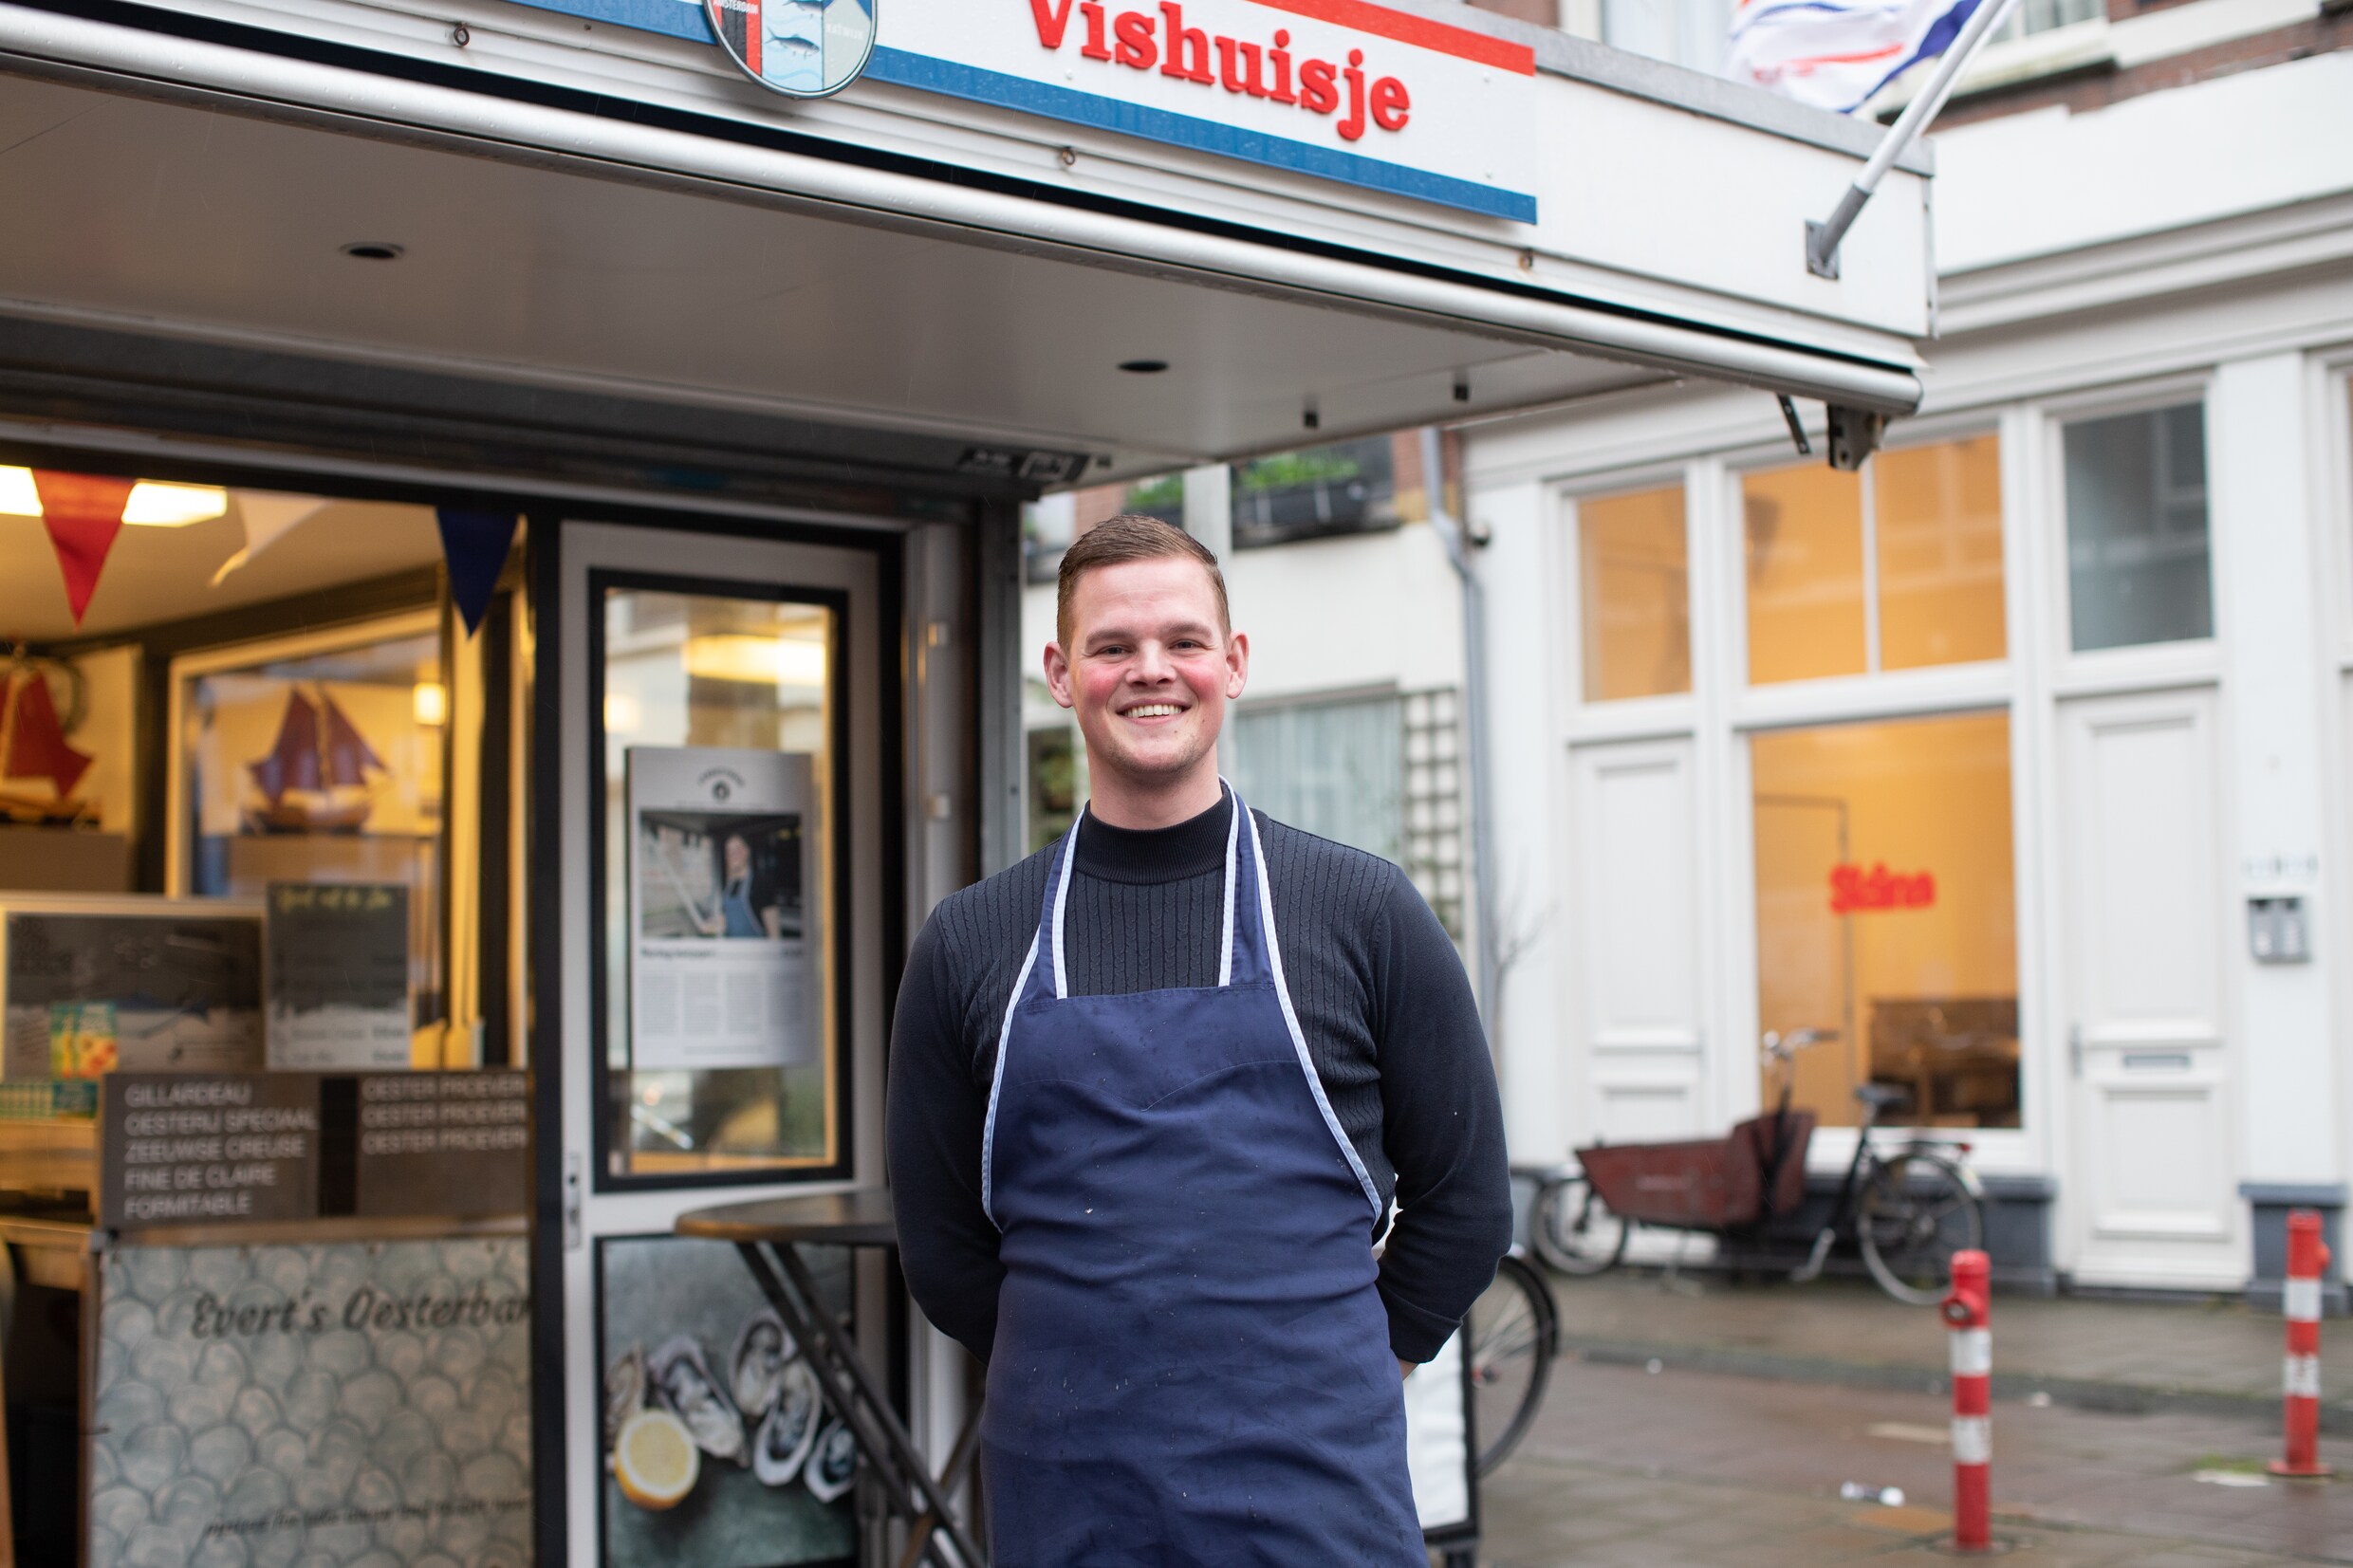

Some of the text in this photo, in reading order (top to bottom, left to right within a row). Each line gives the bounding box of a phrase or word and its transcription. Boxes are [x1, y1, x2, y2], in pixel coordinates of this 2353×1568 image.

[1030, 0, 1411, 140] Vishuisje
[124, 1080, 253, 1108] GILLARDEAU
[124, 1136, 224, 1163] ZEEUWSE
[124, 1162, 277, 1191] FINE DE CLAIRE
[192, 1287, 329, 1339] Evert's
